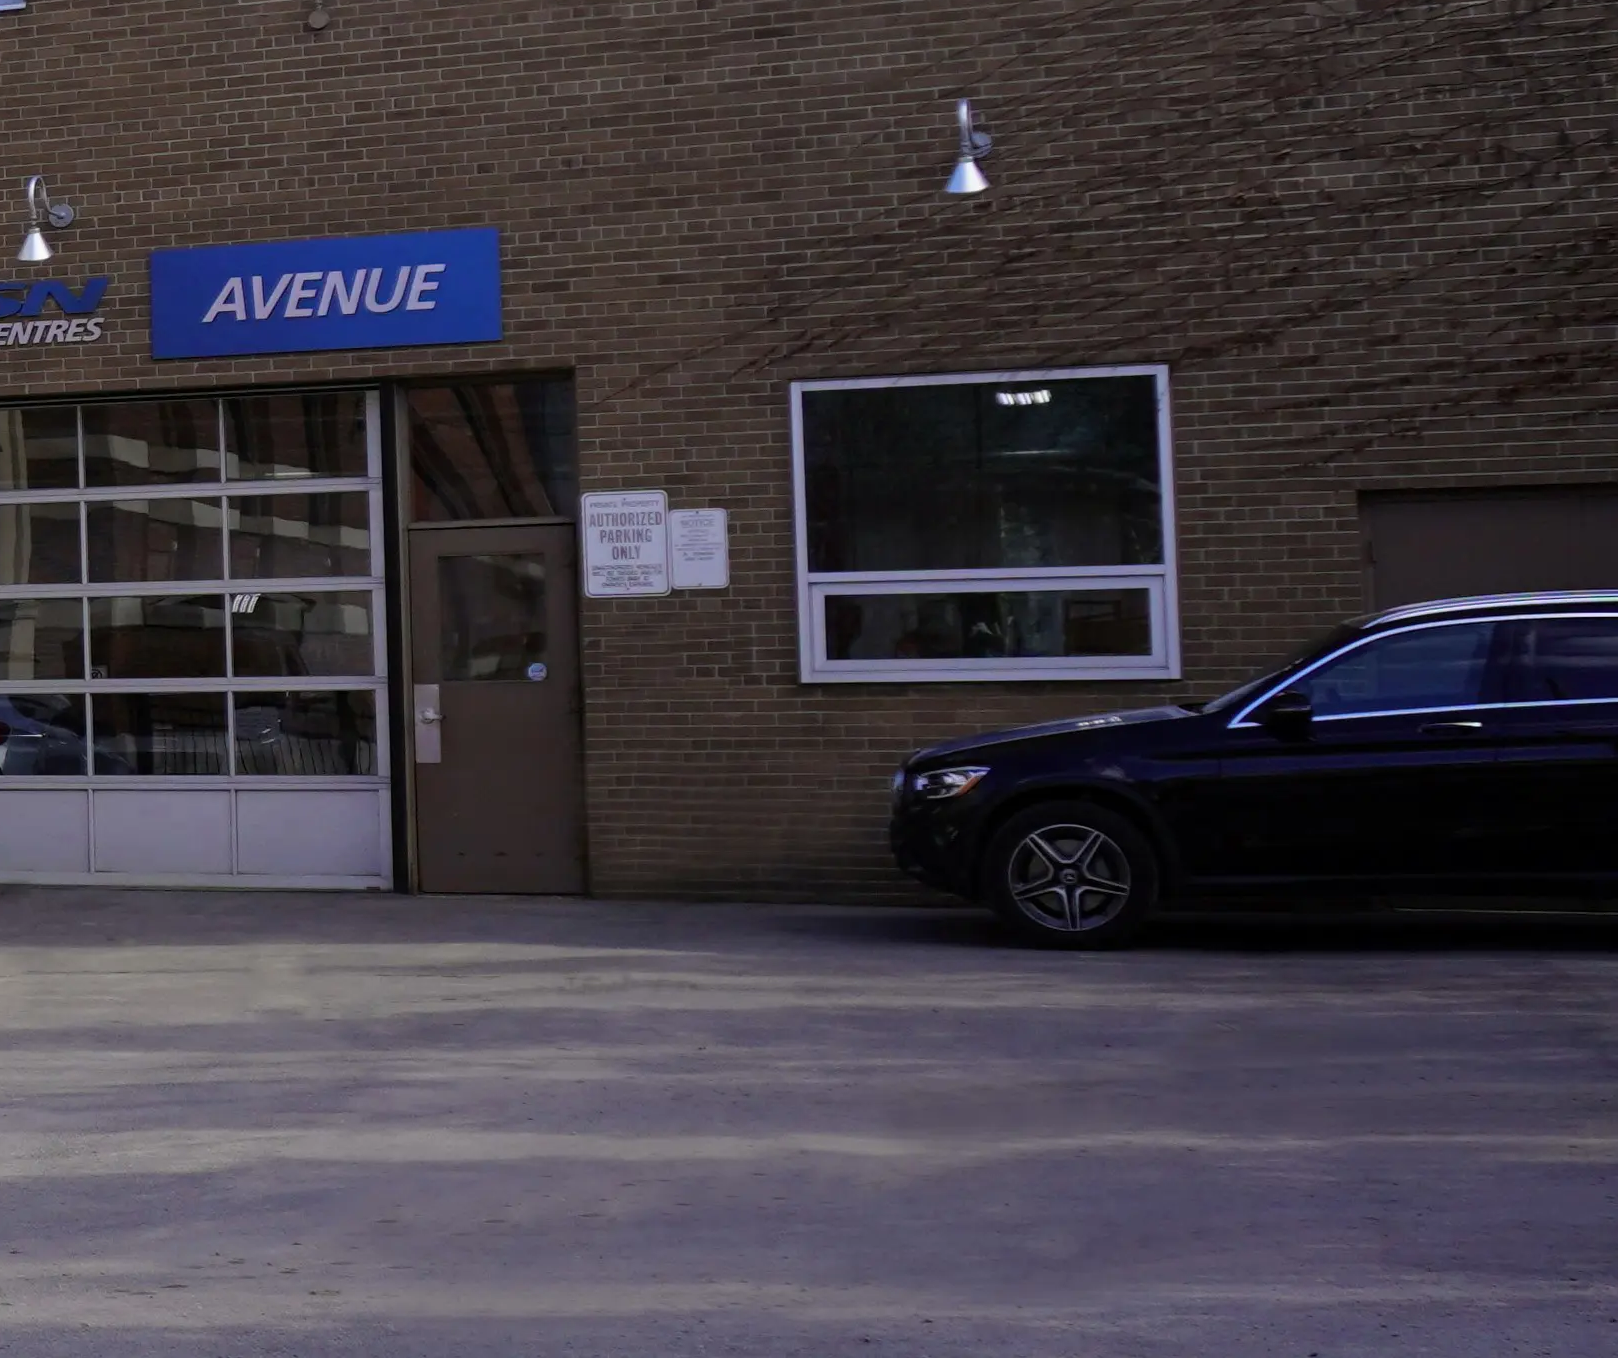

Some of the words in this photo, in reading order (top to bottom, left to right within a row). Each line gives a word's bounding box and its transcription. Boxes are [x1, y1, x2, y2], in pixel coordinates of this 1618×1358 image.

[201, 263, 446, 324] AVENUE
[589, 511, 662, 527] AUTHORIZED
[600, 528, 653, 544] PARKING
[612, 545, 641, 560] ONLY
